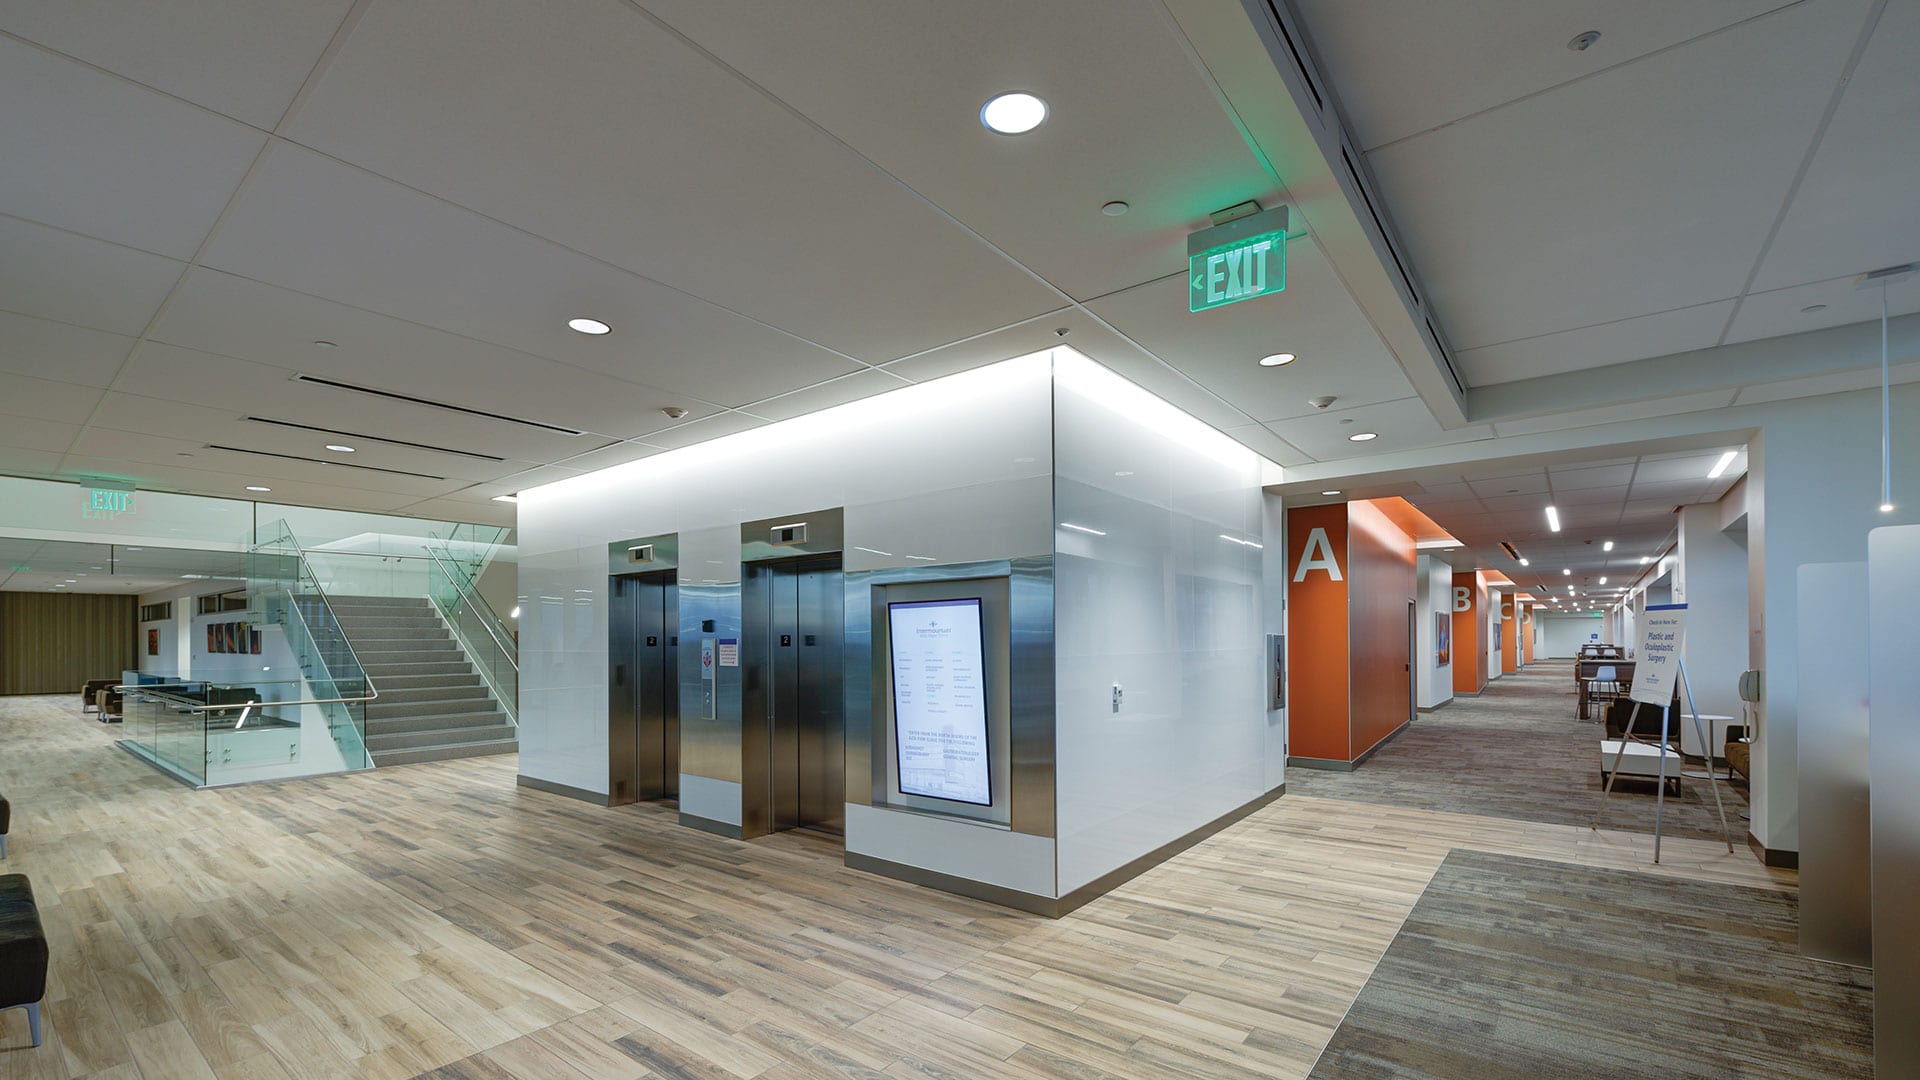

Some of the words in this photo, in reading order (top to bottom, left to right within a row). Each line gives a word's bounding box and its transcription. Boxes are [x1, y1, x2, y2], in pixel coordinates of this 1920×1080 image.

[1207, 240, 1271, 303] EXIT
[91, 489, 128, 512] EXIT
[1293, 527, 1344, 583] A
[1452, 586, 1472, 612] B
[1501, 602, 1512, 620] C
[1648, 631, 1664, 641] Plastic
[1664, 631, 1675, 641] and
[1644, 642, 1674, 653] Oculoplastic
[1648, 653, 1666, 664] Surgery
